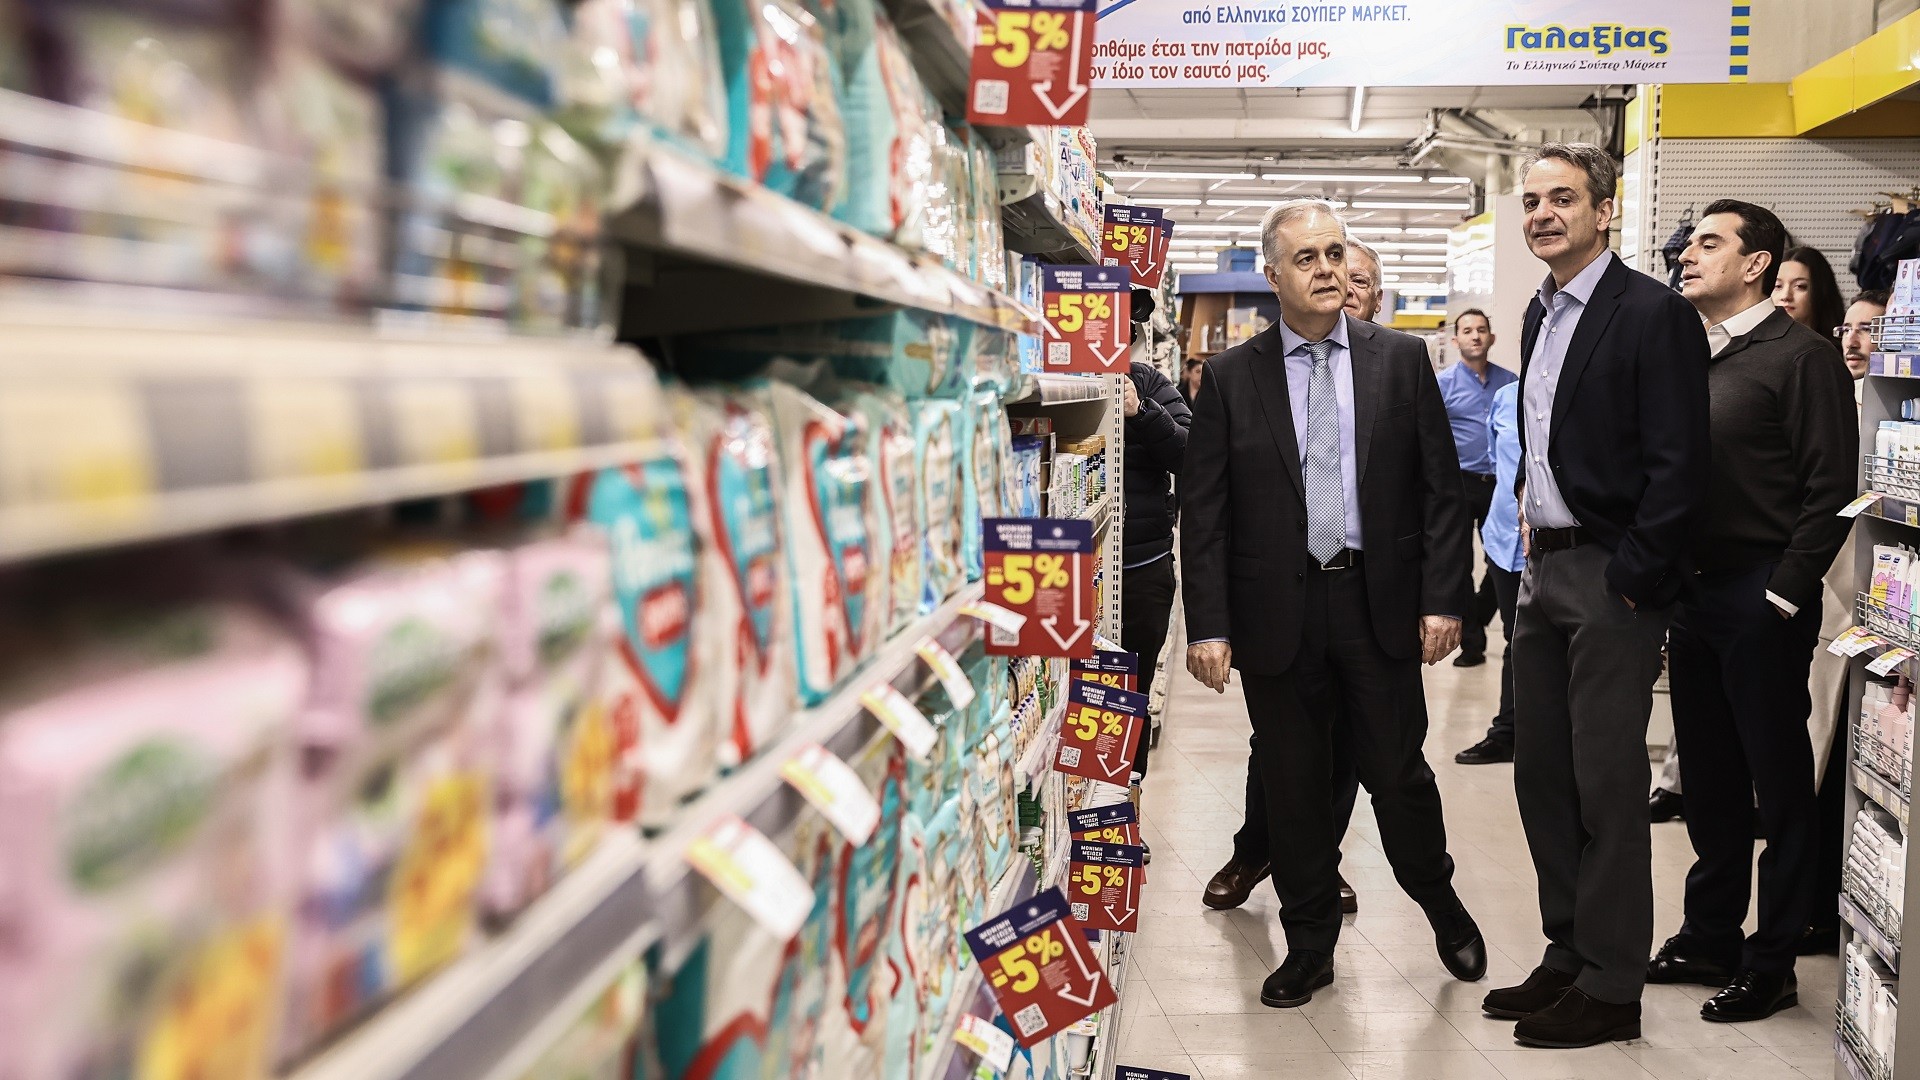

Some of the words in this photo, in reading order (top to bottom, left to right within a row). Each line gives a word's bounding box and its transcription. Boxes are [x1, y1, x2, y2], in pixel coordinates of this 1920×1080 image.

[1183, 5, 1210, 24] από
[1217, 5, 1286, 23] Ελληνικά
[1292, 6, 1347, 22] ΣΟΥΠΕΡ
[1352, 5, 1411, 21] ΜΑΡΚΕΤ.
[1091, 38, 1146, 61] οηθάμε
[1152, 38, 1186, 57] έτσι
[1191, 42, 1219, 57] την
[1225, 37, 1291, 61] πατρίδα
[1298, 41, 1331, 60] μας,
[1090, 66, 1107, 80] ον
[1112, 60, 1144, 79] ίδιο
[1149, 66, 1178, 79] τον
[1184, 61, 1231, 79] εαυτό
[1237, 65, 1270, 82] μας.
[1506, 60, 1520, 71] Το
[1524, 59, 1576, 72] Ελληνικό
[1579, 59, 1620, 72] Σούπερ
[1623, 59, 1667, 71] Μάρκετ
[1104, 225, 1147, 252] -5%
[1046, 293, 1111, 332] -5%
[987, 553, 1069, 605] -5%
[1067, 707, 1123, 741] -5%
[1072, 864, 1124, 895] -5%
[992, 930, 1064, 993] -5%
